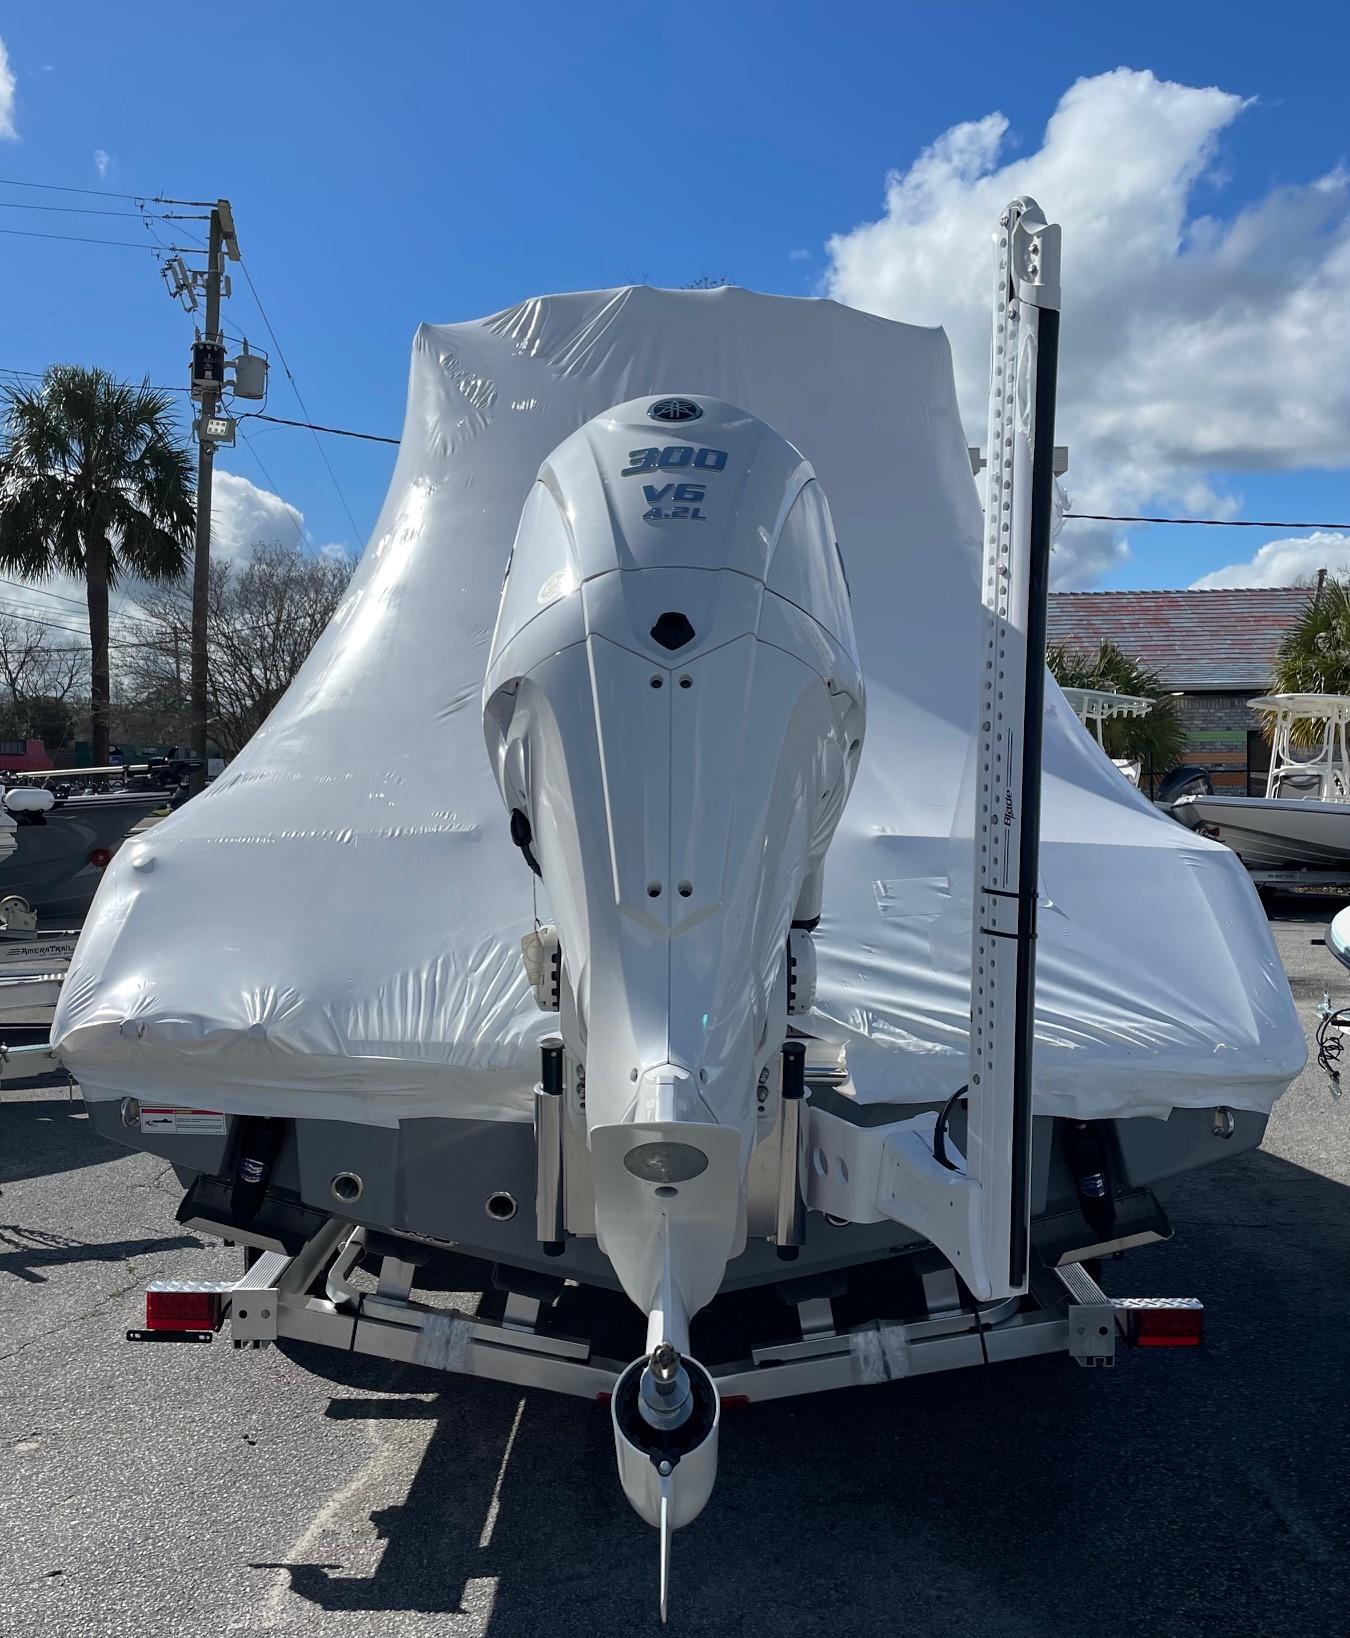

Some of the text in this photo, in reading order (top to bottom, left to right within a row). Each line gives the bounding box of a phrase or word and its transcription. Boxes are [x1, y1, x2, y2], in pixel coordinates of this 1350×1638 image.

[620, 446, 728, 477] 300
[642, 483, 707, 504] V6
[642, 506, 707, 521] 4.2L
[1003, 788, 1016, 827] Blade
